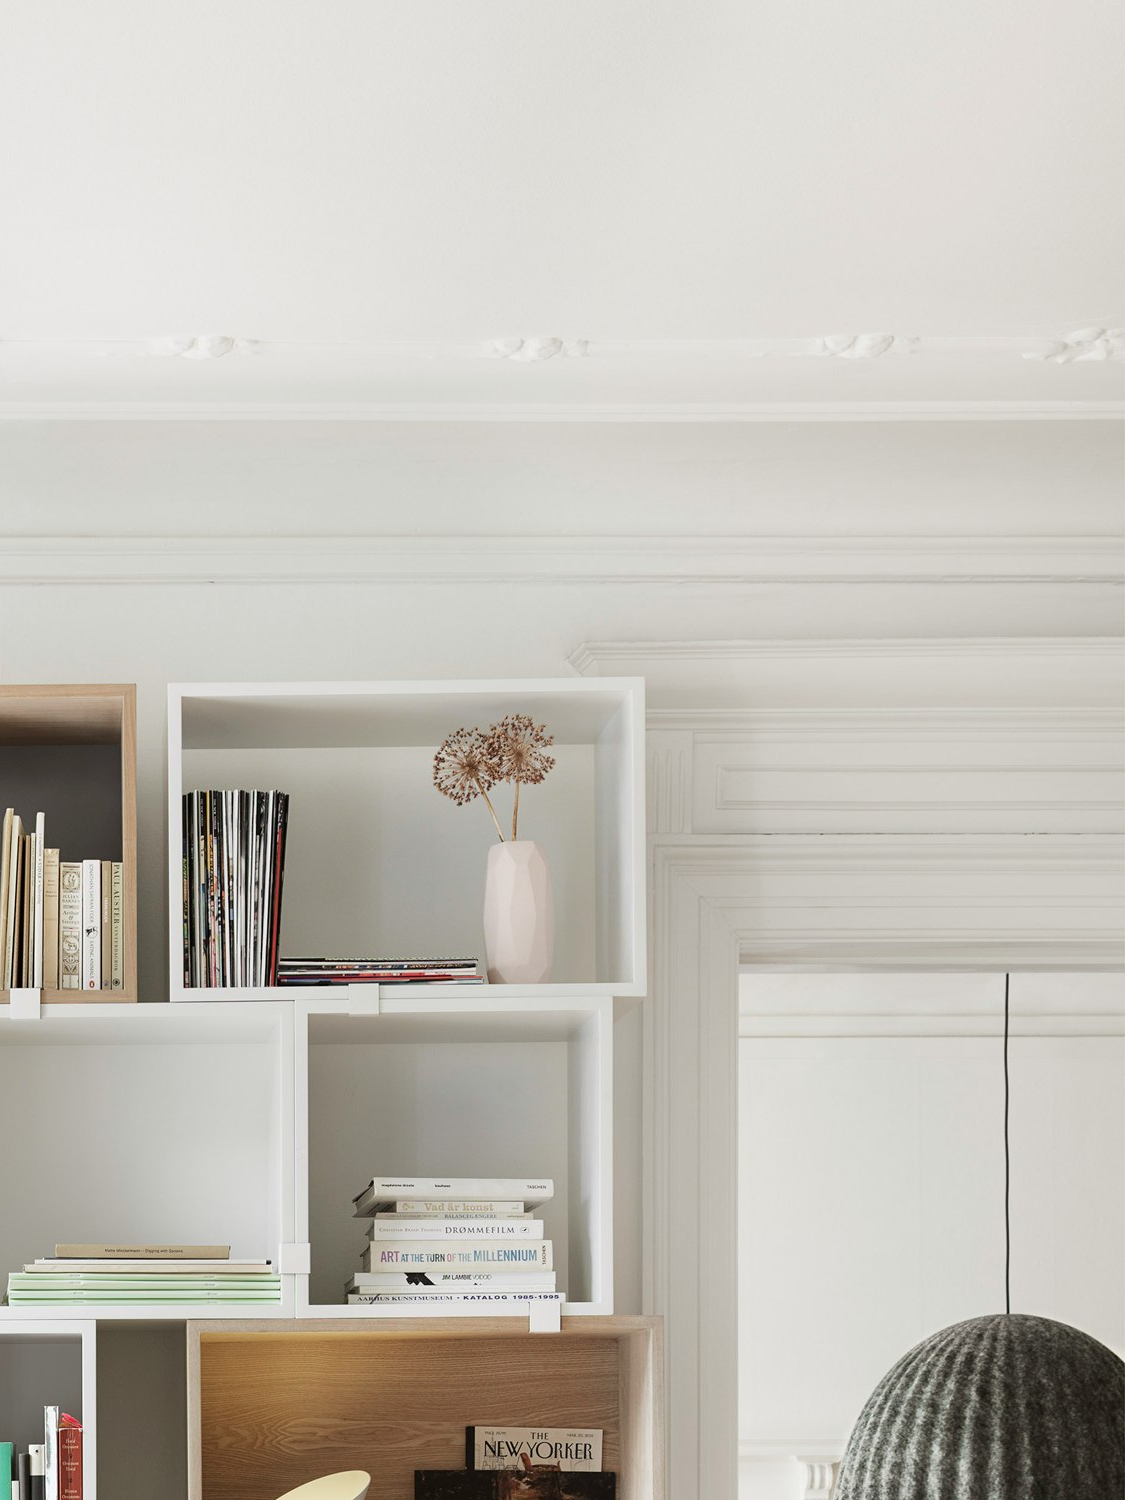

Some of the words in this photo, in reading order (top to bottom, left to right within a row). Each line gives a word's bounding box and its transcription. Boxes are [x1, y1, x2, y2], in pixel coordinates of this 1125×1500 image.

[424, 1202, 445, 1212] Vad
[462, 1202, 494, 1212] konst
[380, 1250, 400, 1263] ART
[400, 1253, 409, 1263] AT
[410, 1253, 425, 1263] THE
[425, 1253, 445, 1263] TURN
[446, 1253, 457, 1262] OF
[458, 1252, 472, 1262] THE
[530, 1432, 549, 1440] THE
[484, 1440, 523, 1458] NEW
[526, 1441, 594, 1460] YORKER
